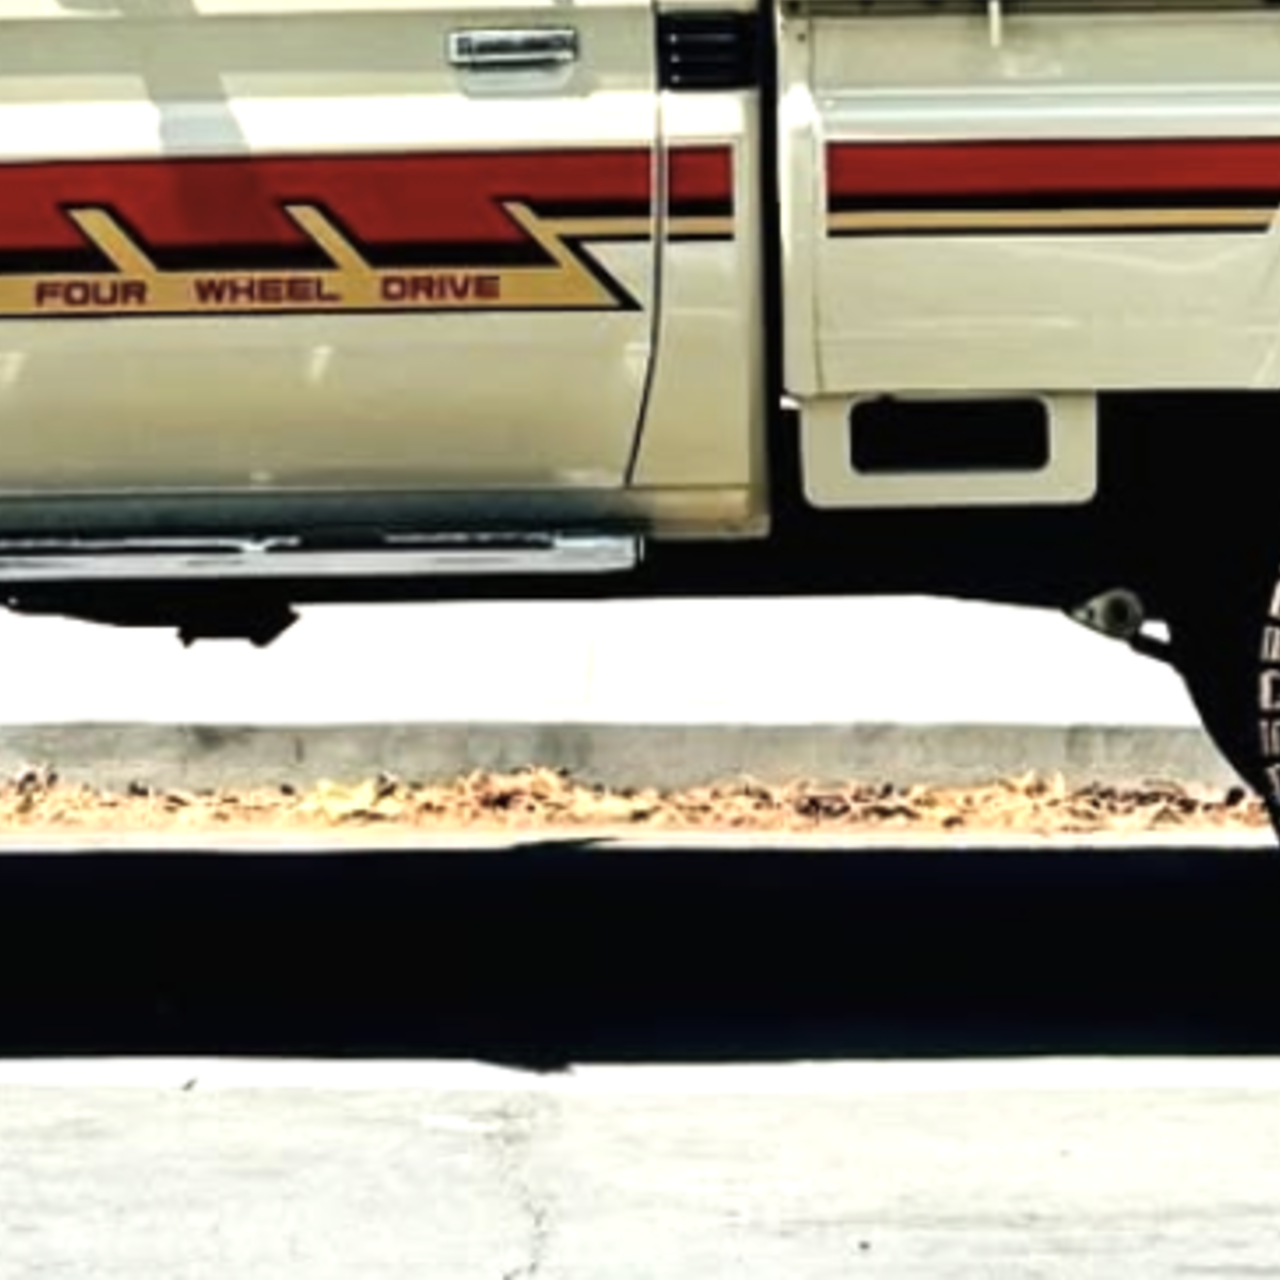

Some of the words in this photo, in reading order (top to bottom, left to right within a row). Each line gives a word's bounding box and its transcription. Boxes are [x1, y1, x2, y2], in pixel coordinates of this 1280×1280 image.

[34, 280, 148, 307] FOUR
[193, 277, 342, 304] WHEEL
[380, 274, 502, 300] DRIVE
